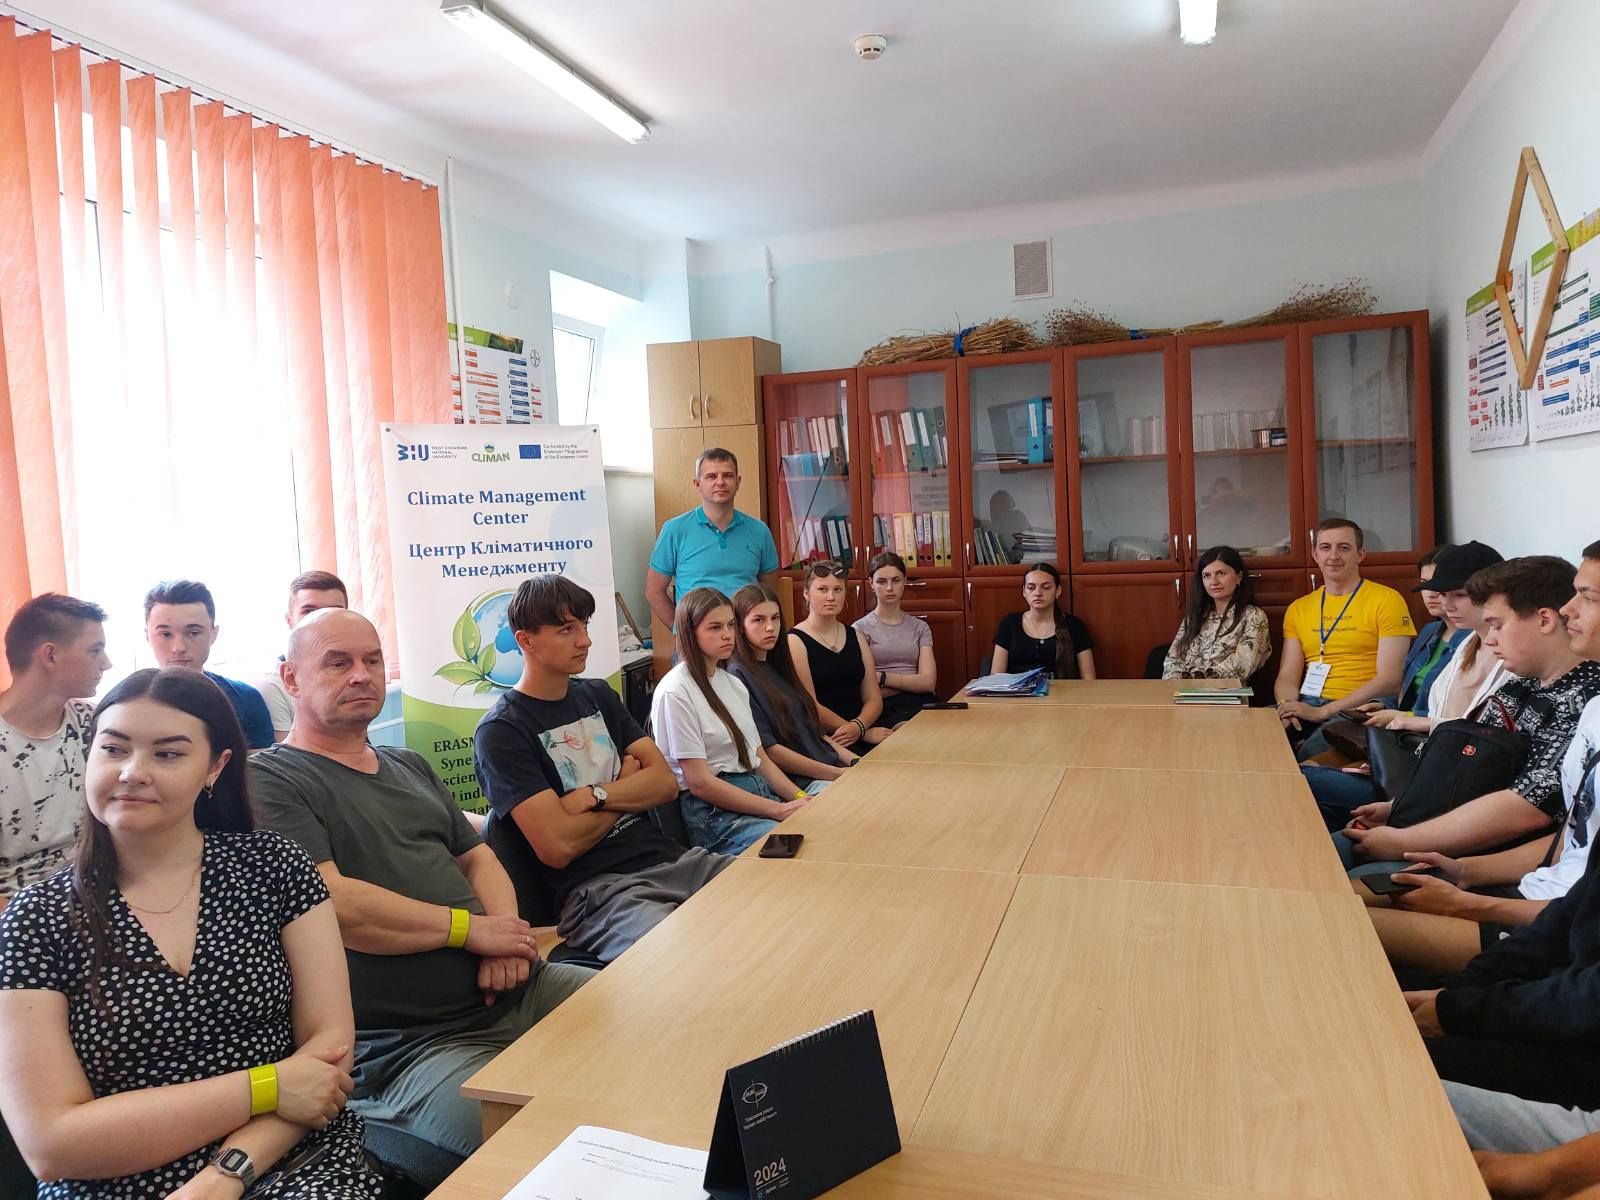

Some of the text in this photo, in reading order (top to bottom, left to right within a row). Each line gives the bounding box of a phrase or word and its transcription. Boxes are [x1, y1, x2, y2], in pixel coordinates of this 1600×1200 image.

[471, 452, 511, 463] CLIMAN
[407, 489, 587, 506] Climate Management
[473, 511, 529, 526] Center
[408, 539, 593, 560] Центр Кліматичного
[441, 560, 567, 578] Менеджменту
[753, 1157, 787, 1186] 2024
